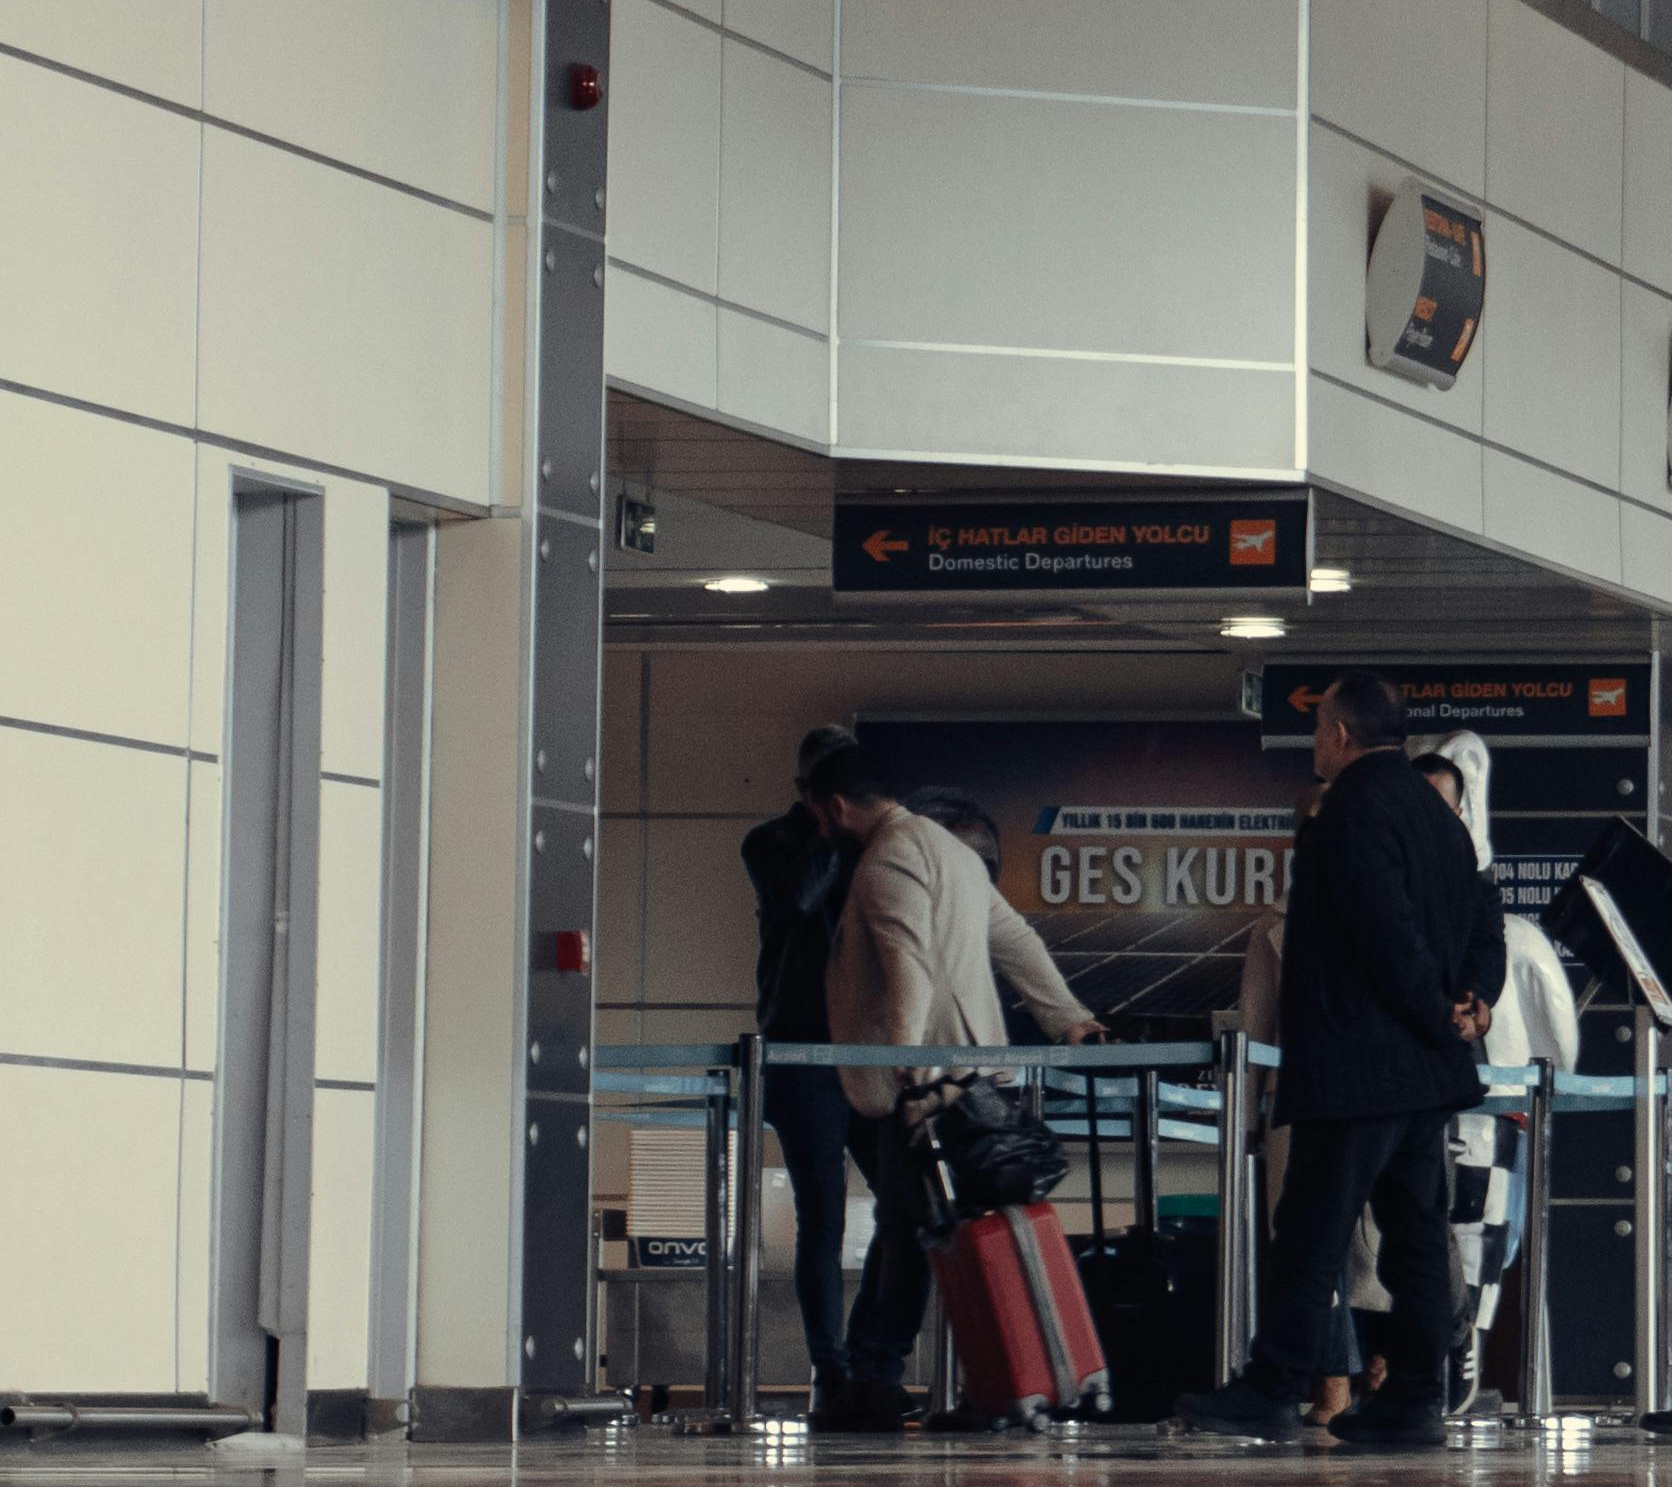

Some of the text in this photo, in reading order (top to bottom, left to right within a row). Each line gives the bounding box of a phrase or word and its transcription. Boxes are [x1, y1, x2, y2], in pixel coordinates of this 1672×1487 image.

[927, 522, 1210, 549] İÇ HATLAR GİDEN YOLCU
[929, 551, 1133, 573] Domestic Departures
[1402, 679, 1572, 698] TLAR GİDEN YOLCU
[1439, 703, 1524, 720] Departures
[1239, 811, 1296, 830] ELEKTRİ
[1040, 845, 1143, 905] GES
[1517, 862, 1551, 880] NOLU
[1517, 887, 1551, 904] NOLU
